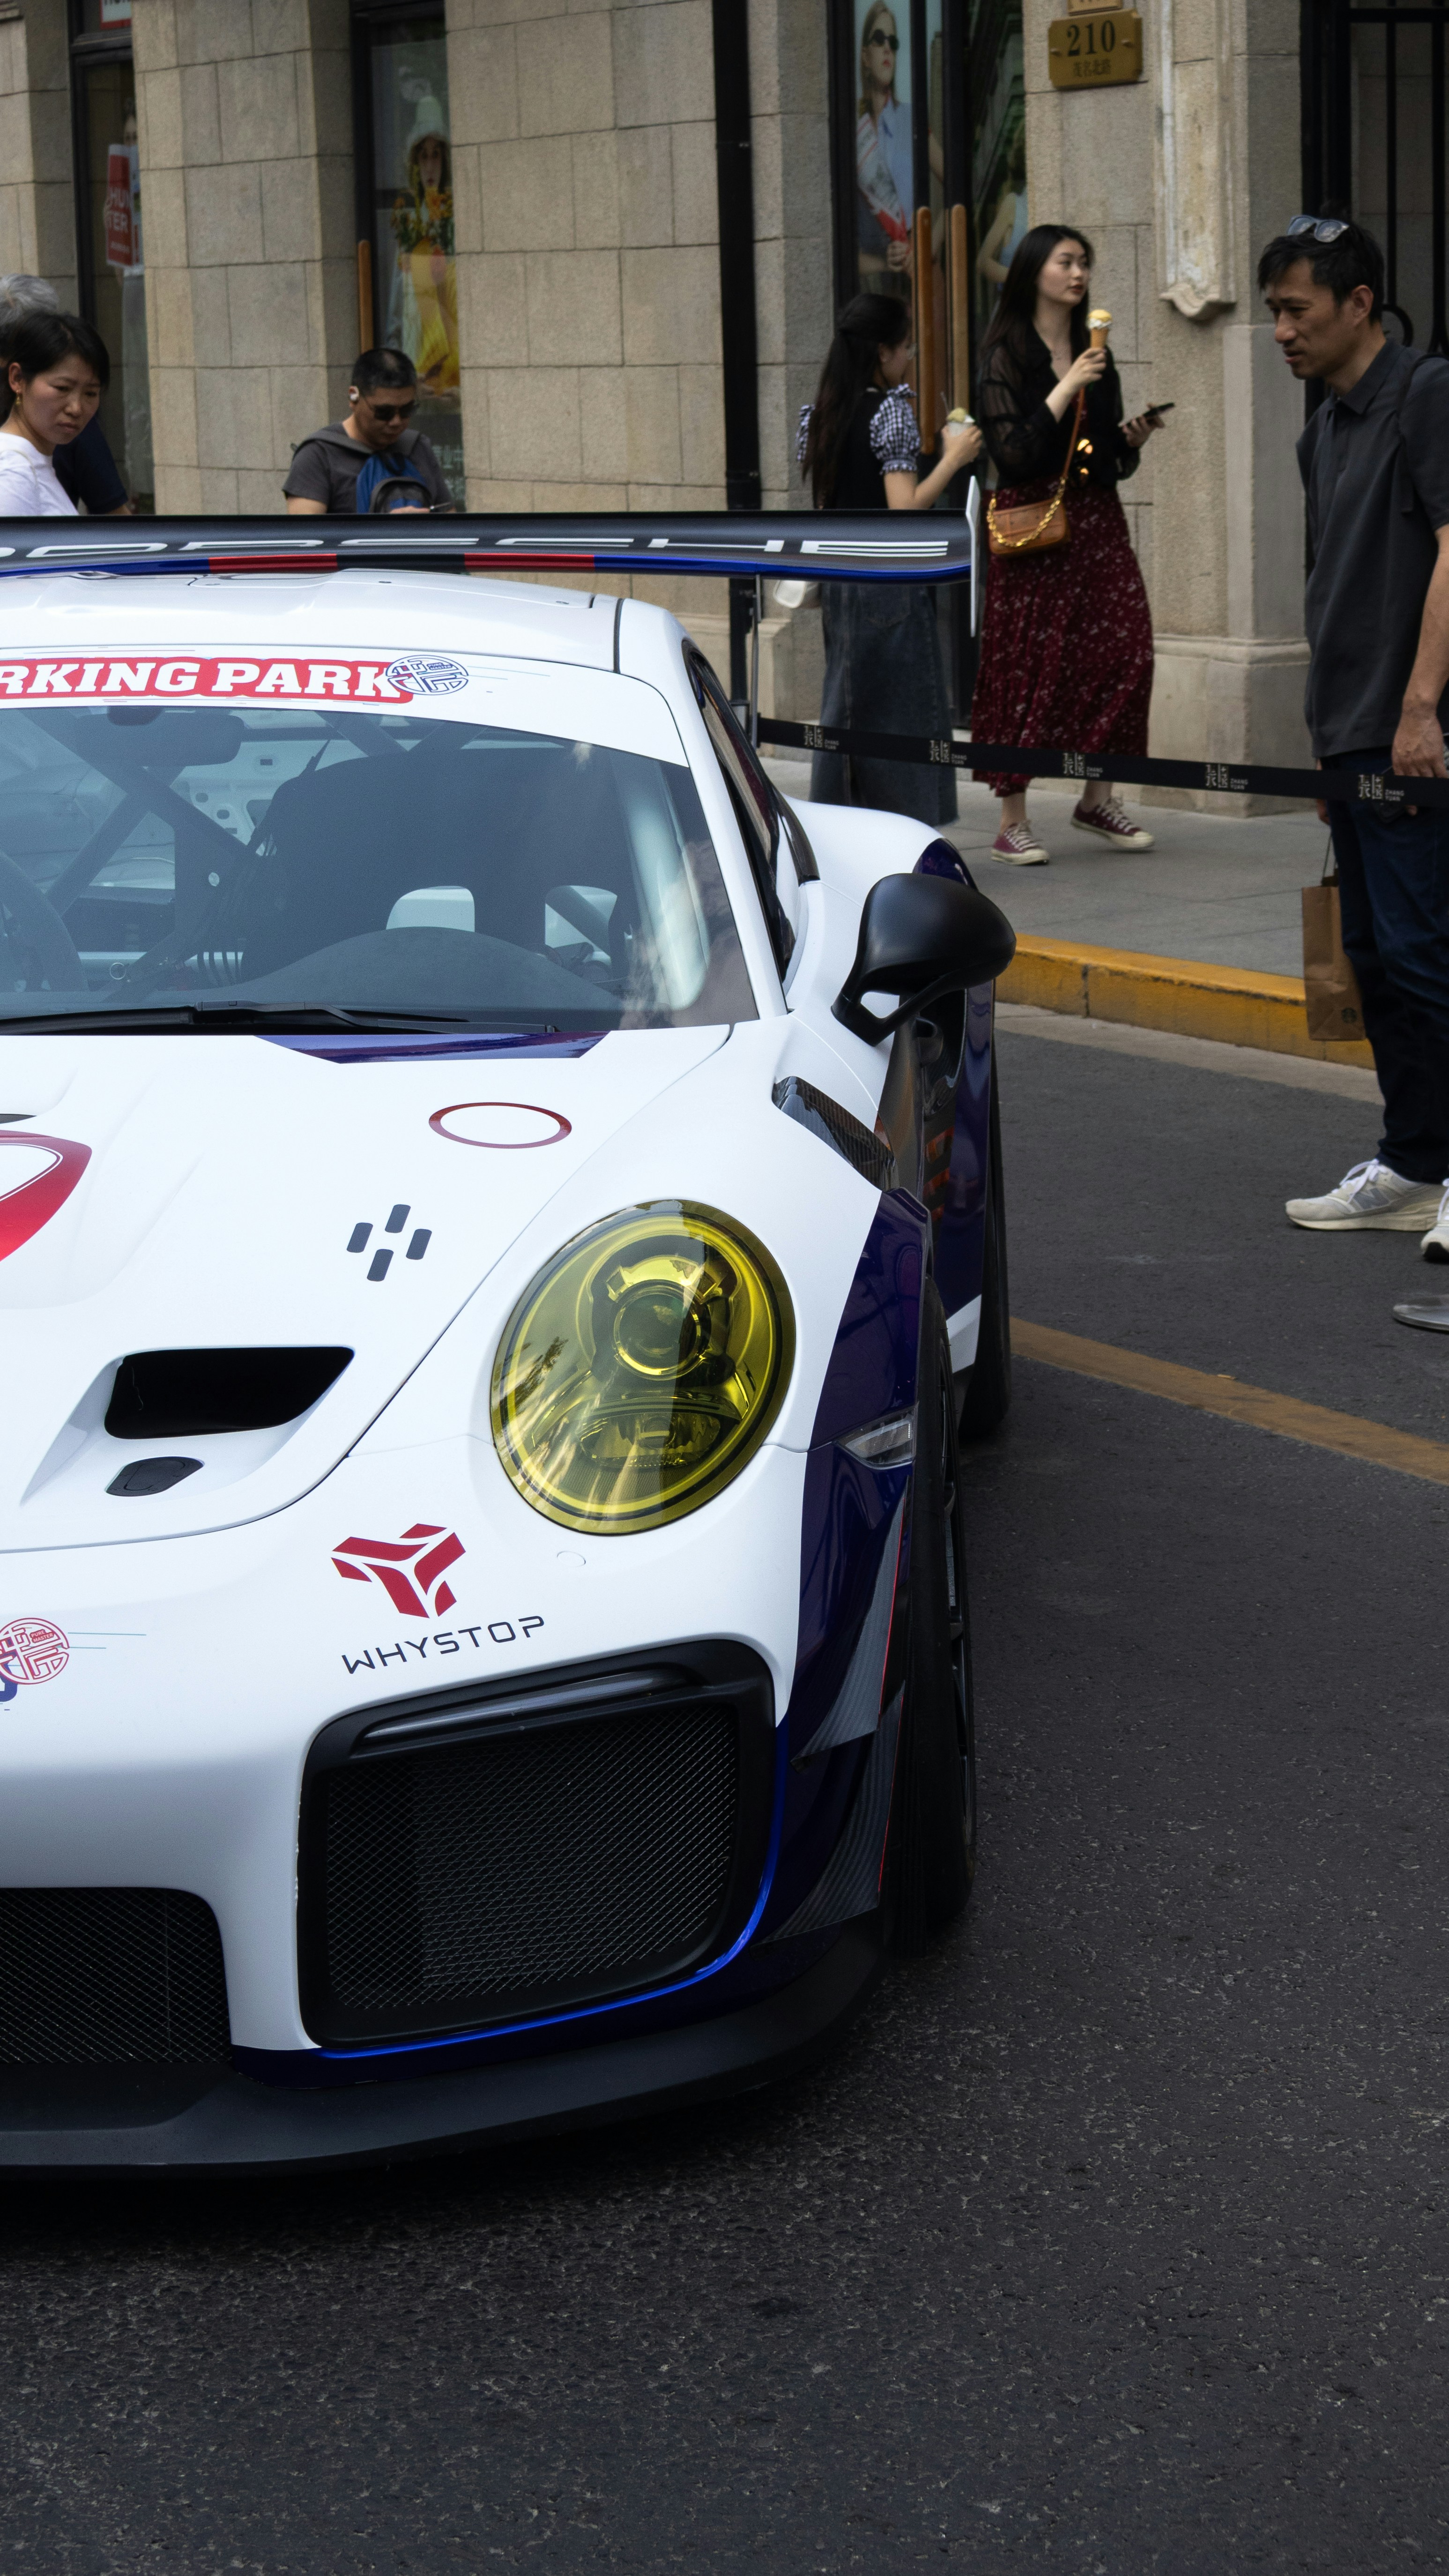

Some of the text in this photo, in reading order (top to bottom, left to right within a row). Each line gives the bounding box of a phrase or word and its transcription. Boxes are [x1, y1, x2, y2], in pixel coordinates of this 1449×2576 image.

[1067, 20, 1116, 57] 210
[211, 662, 401, 698] PARK
[31, 1630, 45, 1638] PURE
[34, 1633, 53, 1642] MASTER
[342, 1616, 544, 1674] WHYSTOP
